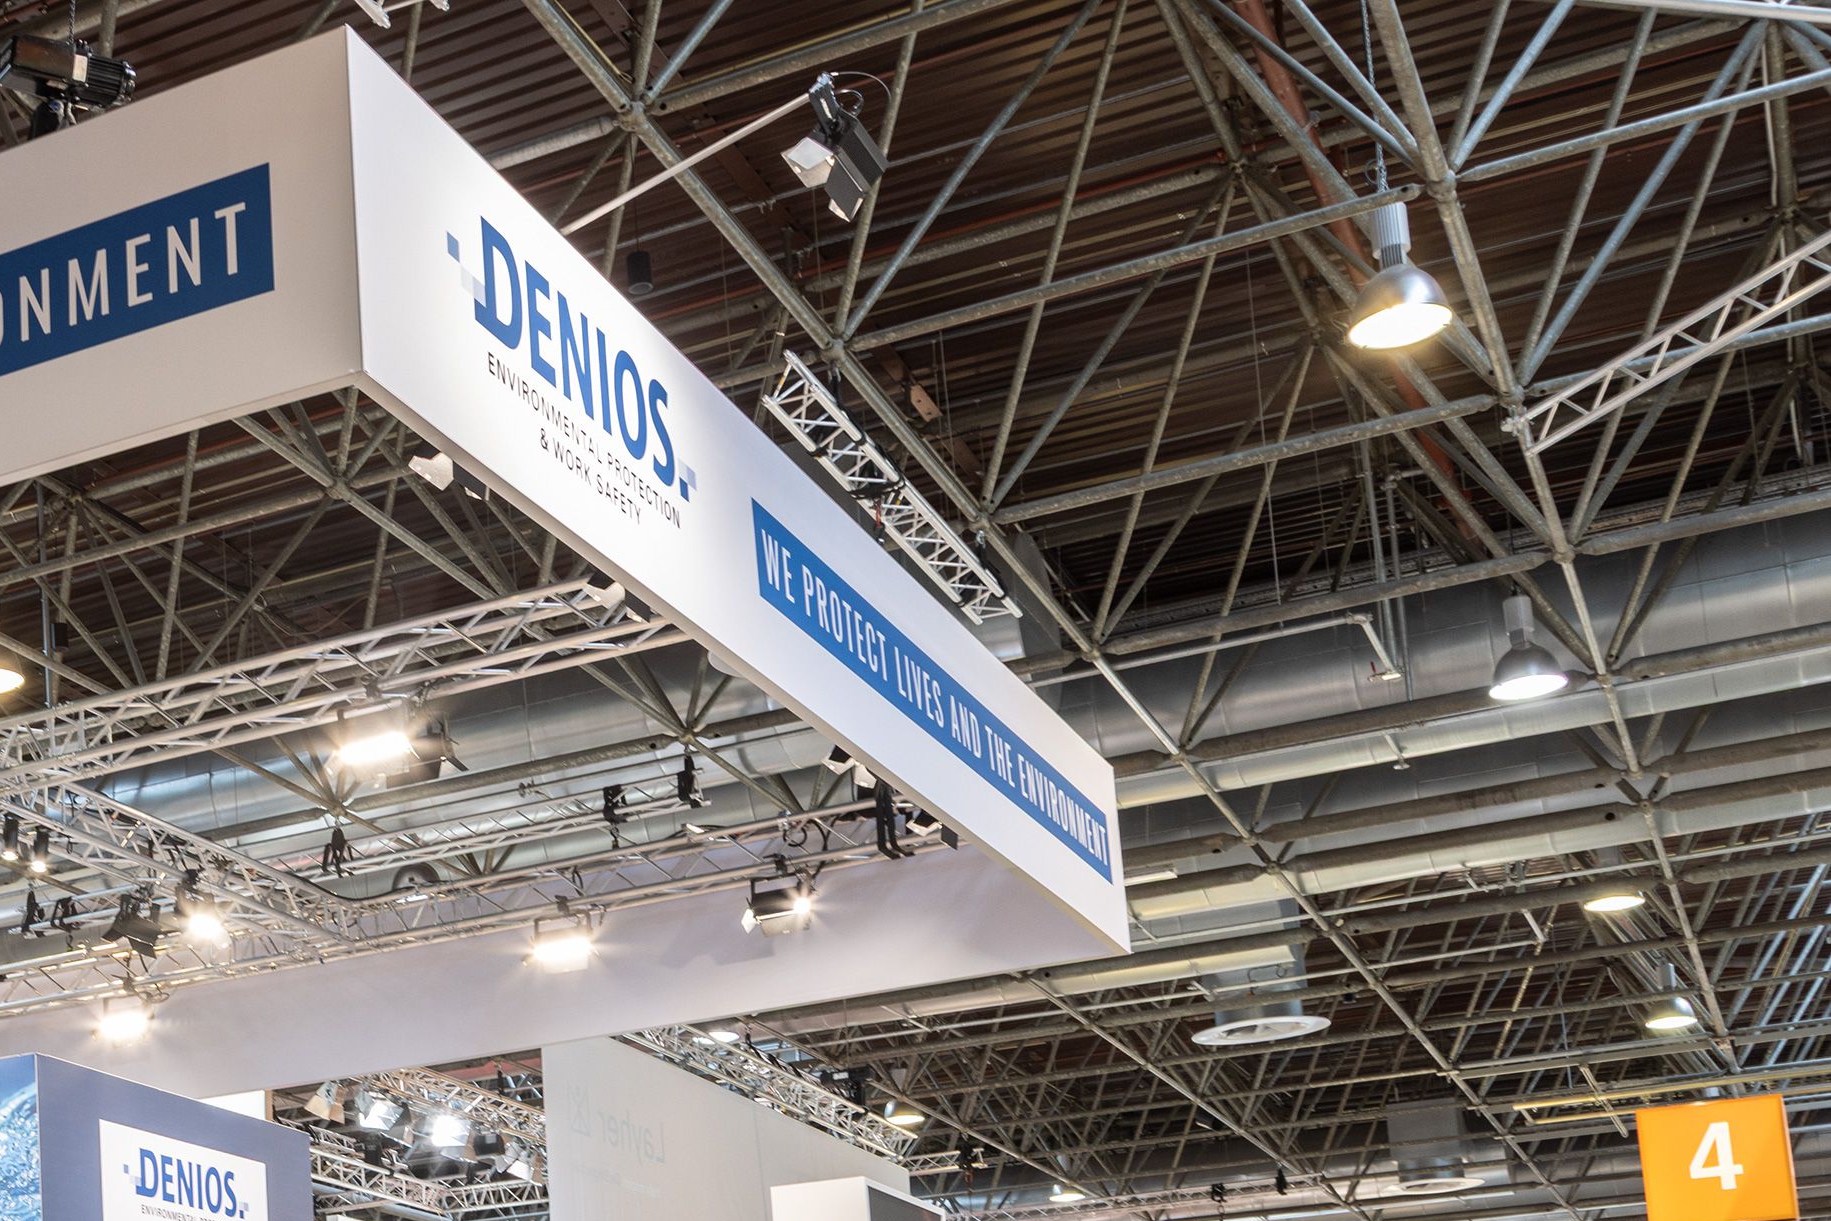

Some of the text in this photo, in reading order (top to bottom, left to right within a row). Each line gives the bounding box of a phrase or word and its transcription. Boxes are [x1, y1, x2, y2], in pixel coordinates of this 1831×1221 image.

[488, 352, 681, 529] ENVIRONMENTAL PROTECTION
[540, 428, 642, 525] & WORK SAFETY
[761, 528, 1109, 867] WE PROTECT LIVES AND THE ENVIRONMENT
[1689, 1121, 1744, 1190] 4
